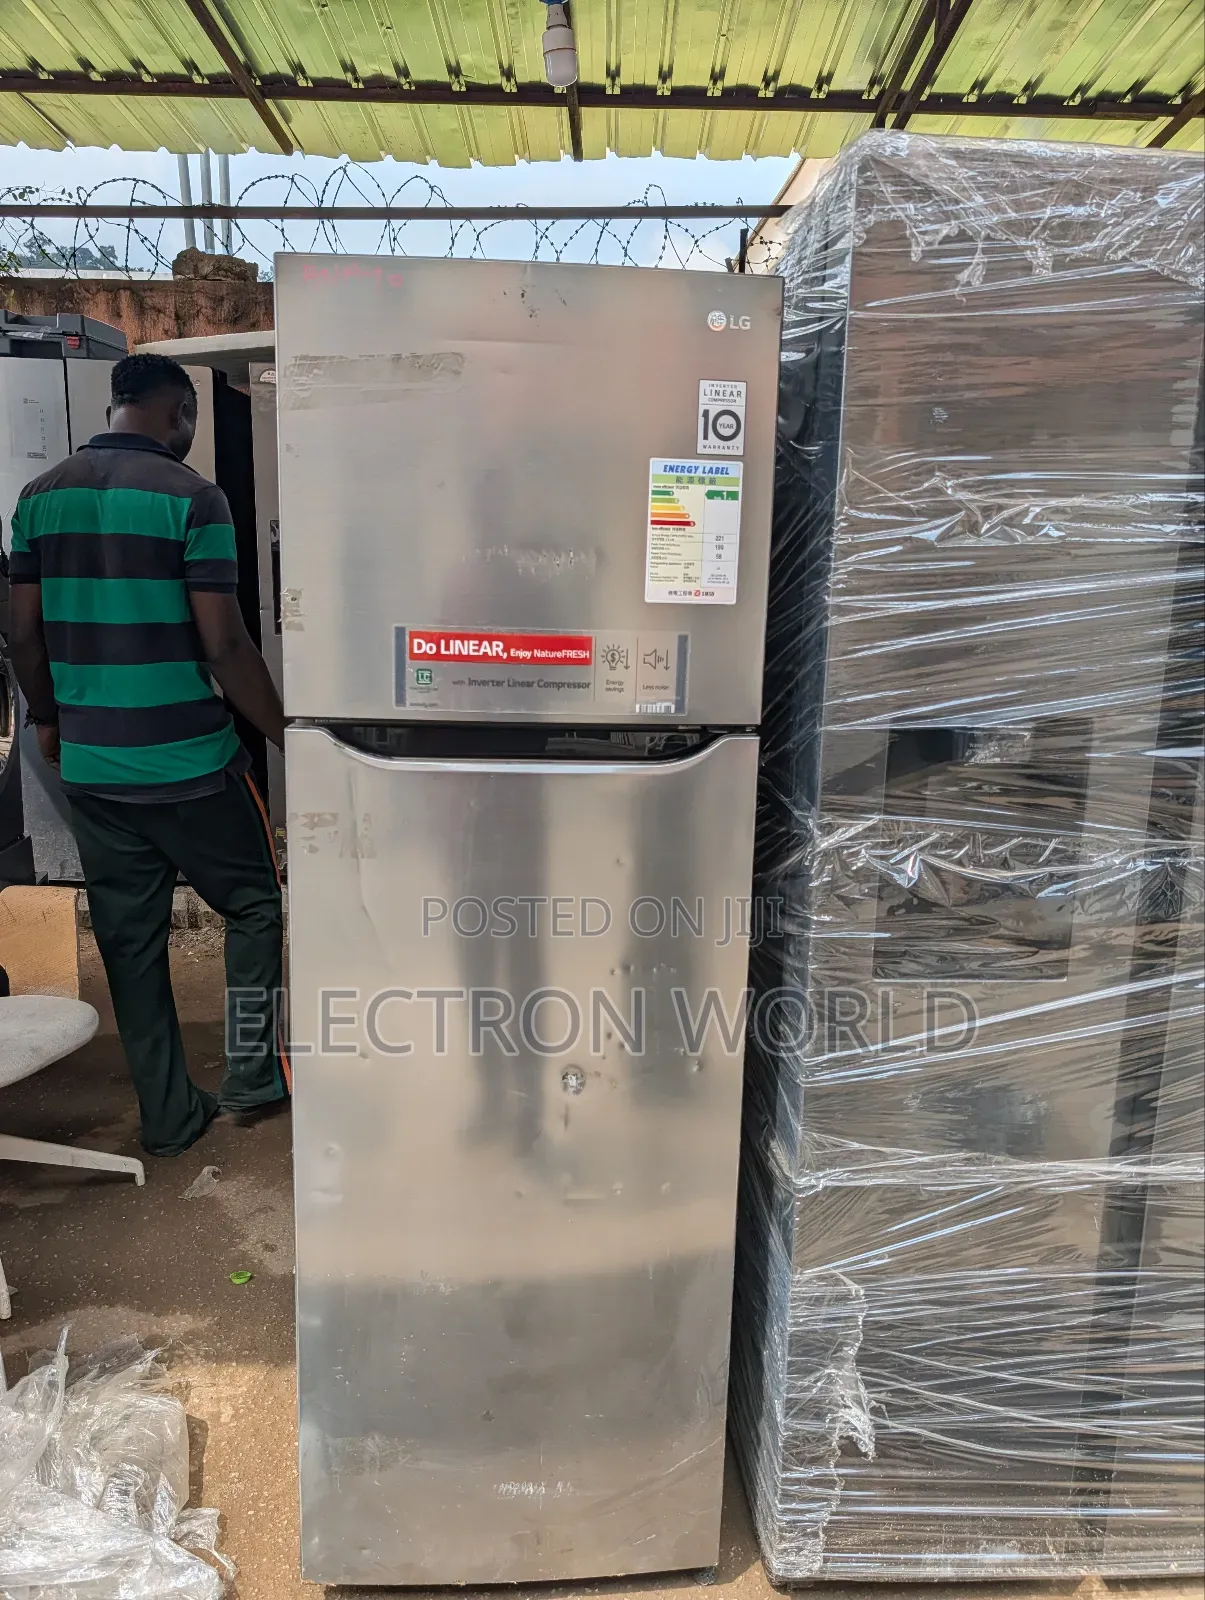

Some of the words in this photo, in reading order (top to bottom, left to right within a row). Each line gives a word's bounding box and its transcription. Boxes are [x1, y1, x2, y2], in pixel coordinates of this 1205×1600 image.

[729, 314, 751, 330] LG
[703, 388, 742, 398] LINEAR
[701, 409, 742, 442] 10
[718, 422, 734, 430] YEAR
[663, 464, 700, 475] ENERGY
[702, 466, 730, 476] LABEL
[412, 638, 437, 655] Do
[440, 639, 508, 660] LINEAR,
[510, 648, 532, 660] Enjoy
[533, 649, 590, 660] NatureFRESH
[468, 677, 506, 689] Inverter
[507, 679, 535, 689] Linear
[537, 678, 592, 691] Compressor
[605, 679, 624, 687] Energy
